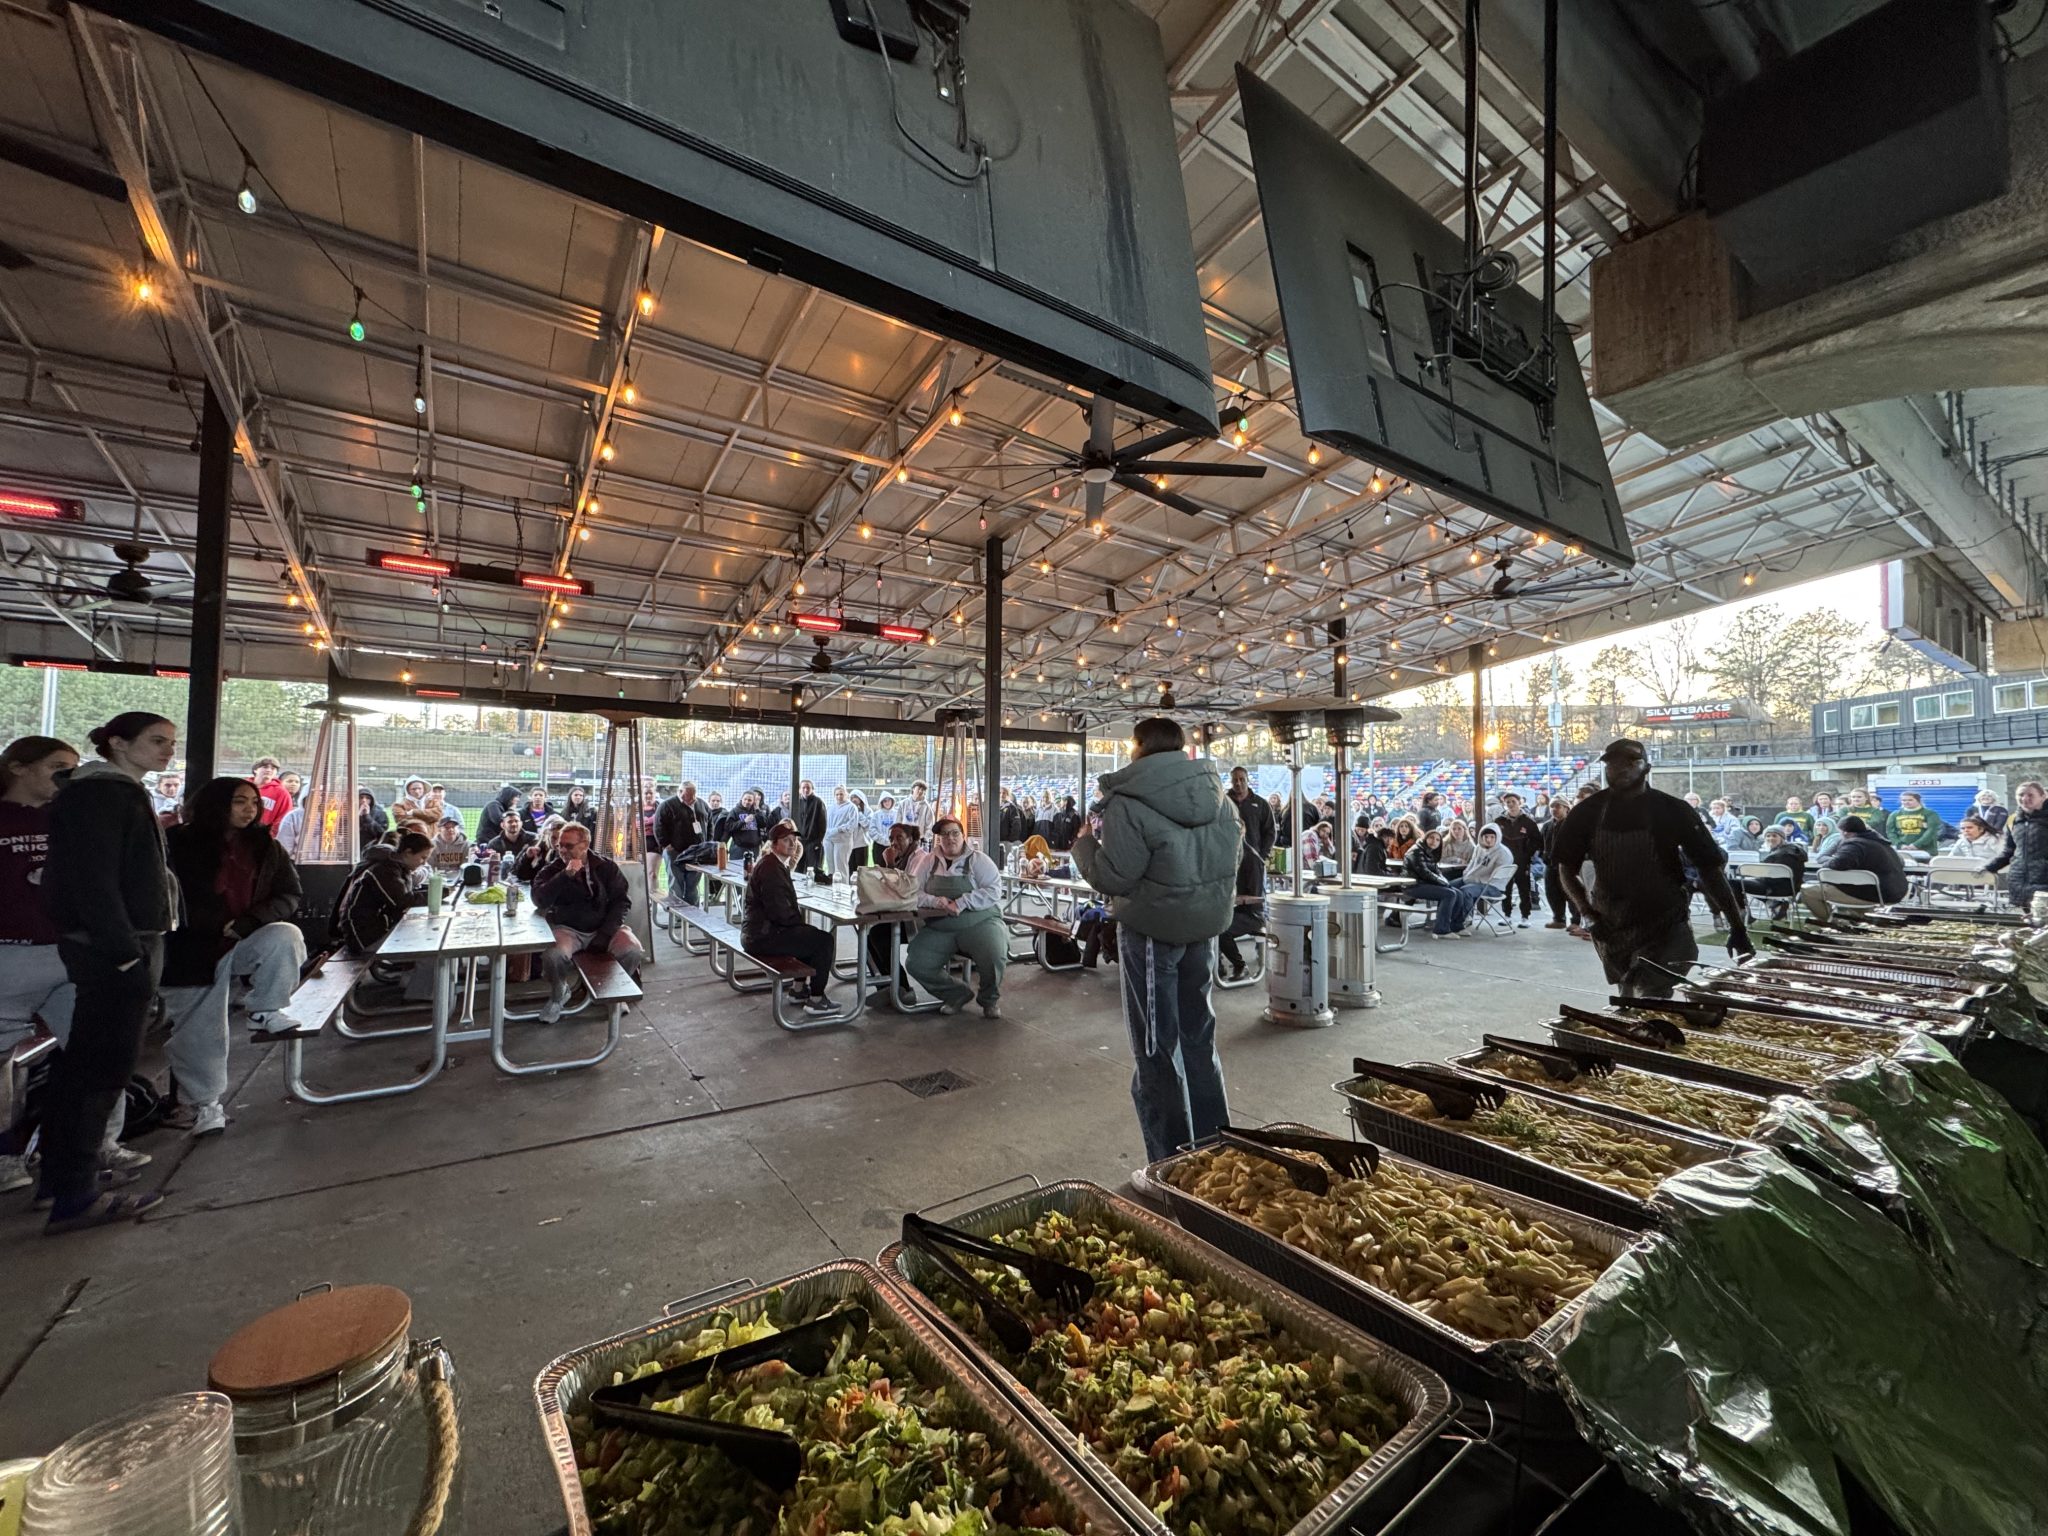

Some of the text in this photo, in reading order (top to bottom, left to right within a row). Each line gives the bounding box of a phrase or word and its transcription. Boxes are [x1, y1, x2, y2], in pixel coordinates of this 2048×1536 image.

[1646, 703, 1732, 717] SILVERBACKS
[1693, 711, 1730, 720] PARK
[12, 843, 49, 853] RUG
